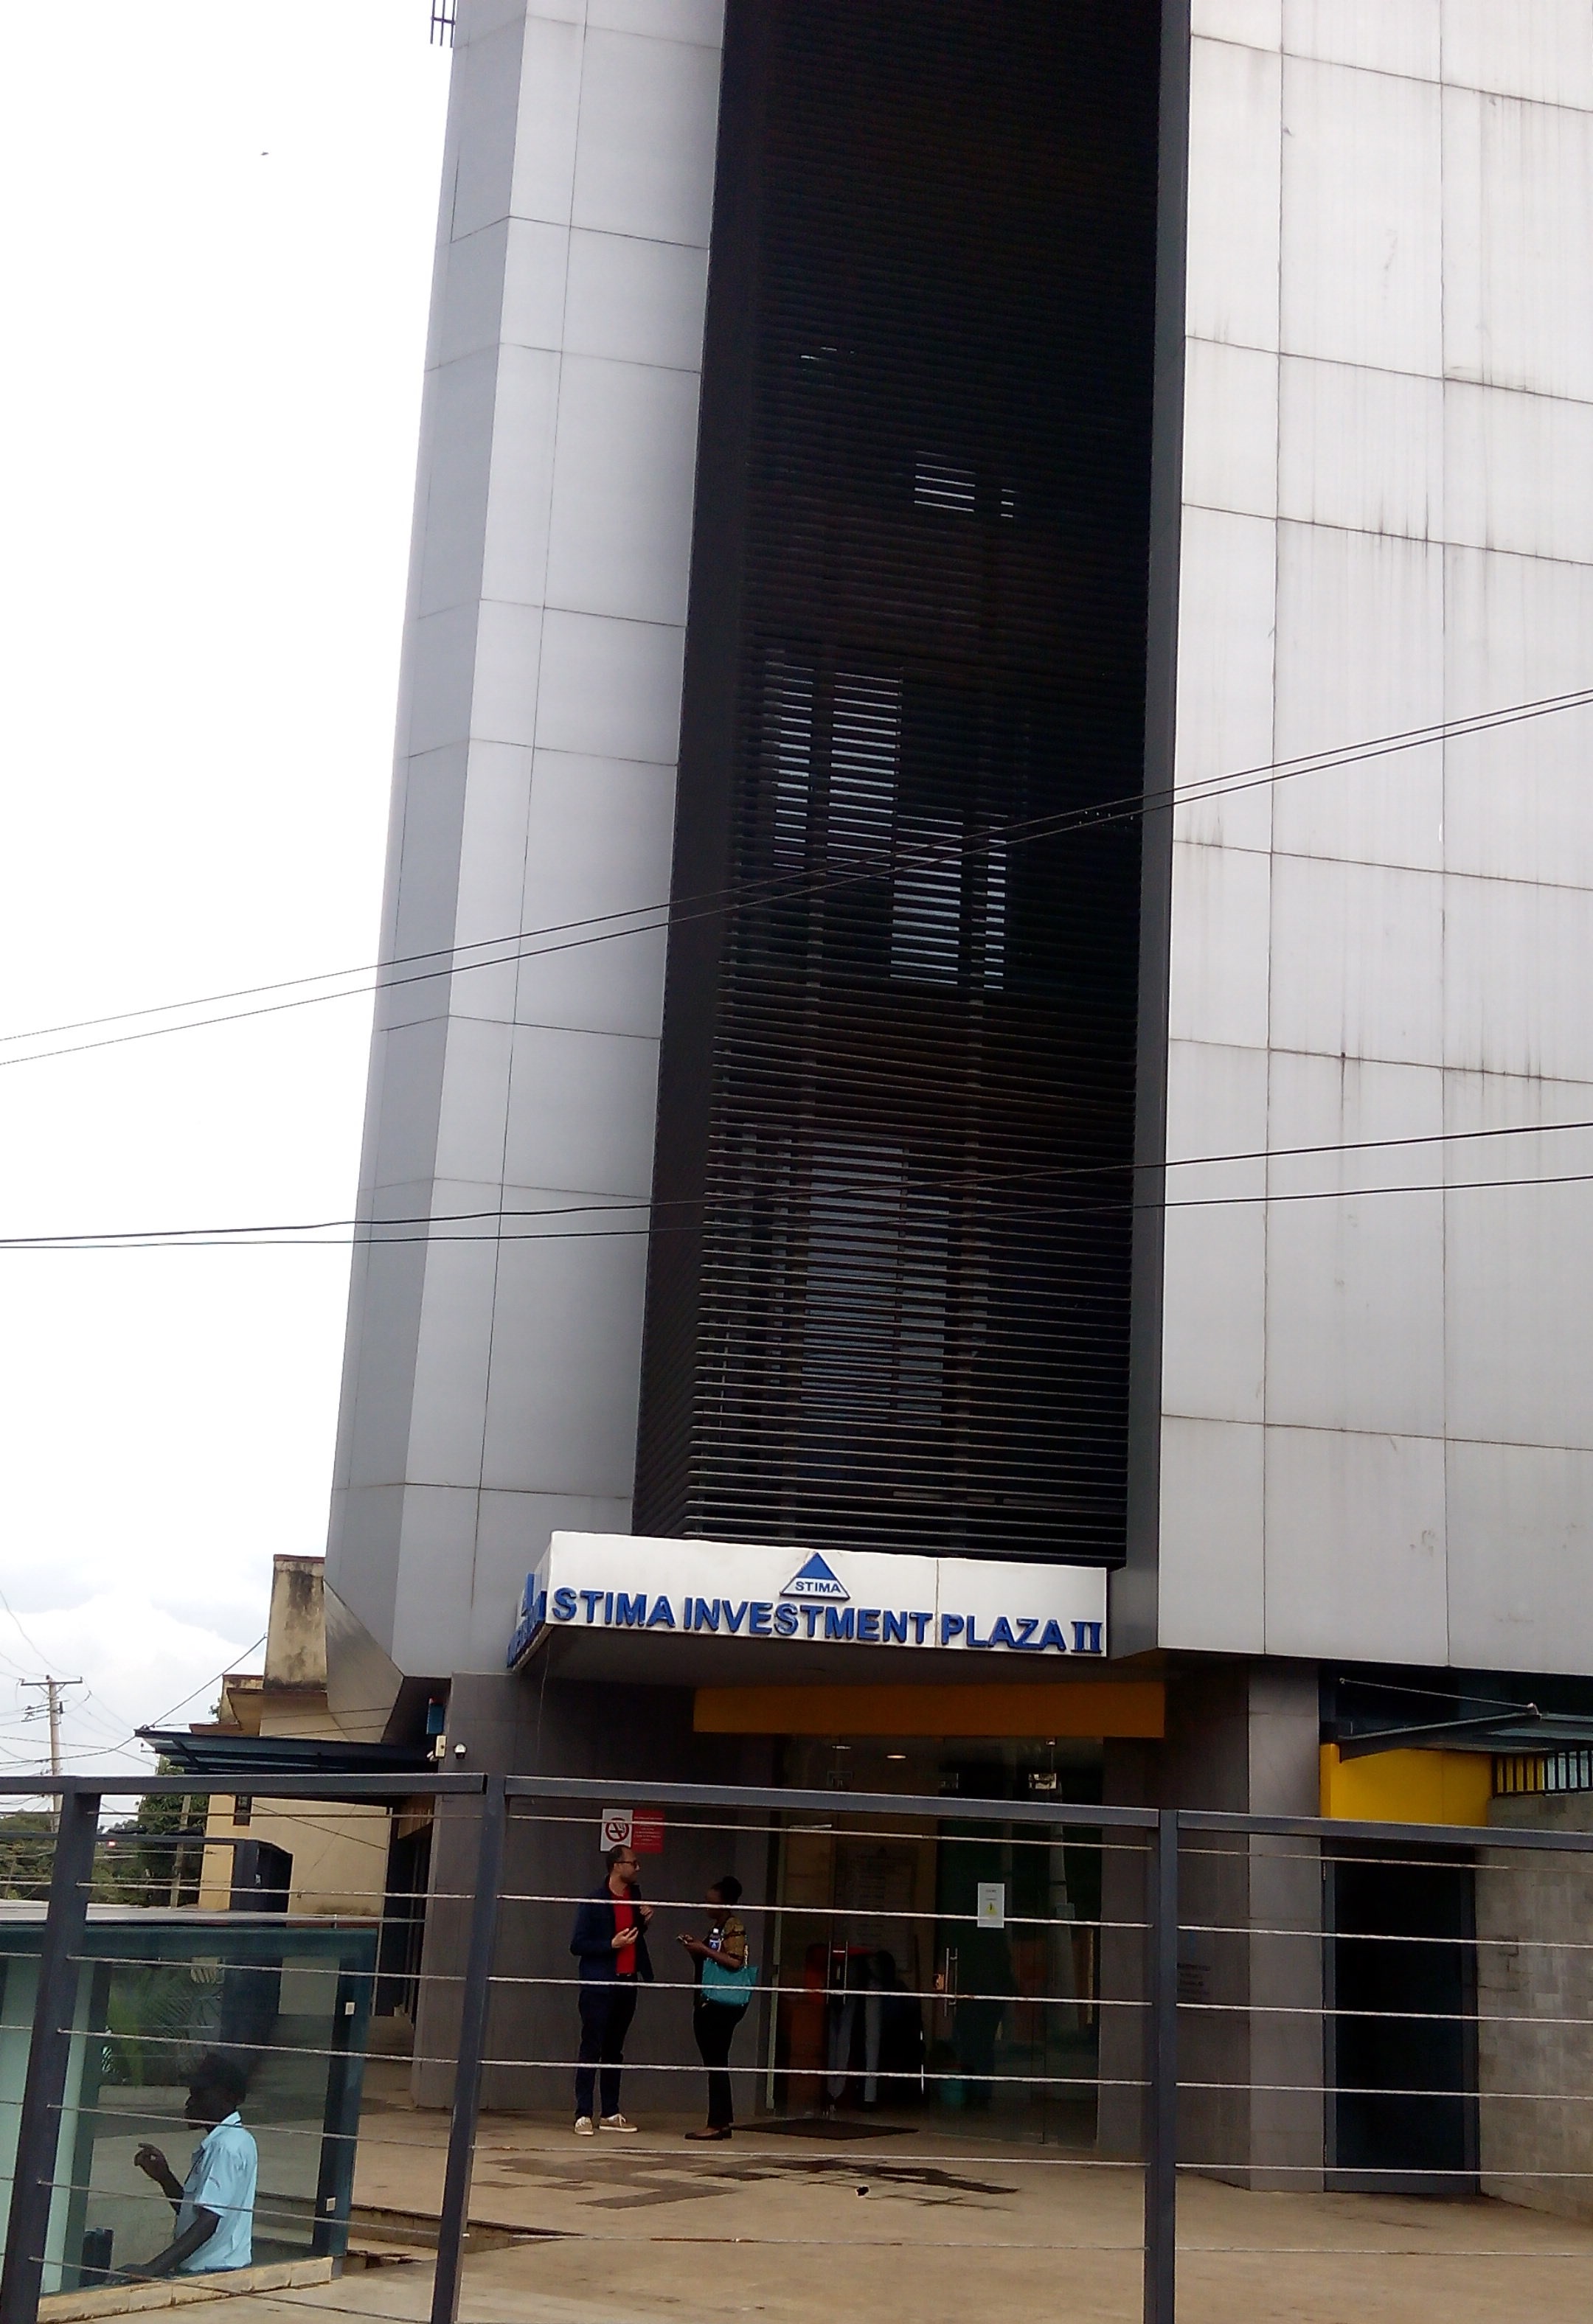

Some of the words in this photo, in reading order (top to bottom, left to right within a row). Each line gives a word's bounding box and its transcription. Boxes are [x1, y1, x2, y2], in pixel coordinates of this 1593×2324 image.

[795, 1581, 841, 1593] STIMA
[552, 1587, 675, 1628] STIMA
[684, 1597, 933, 1644] INVESTMENT
[942, 1613, 1066, 1652] PLAZA
[1071, 1621, 1103, 1654] II
